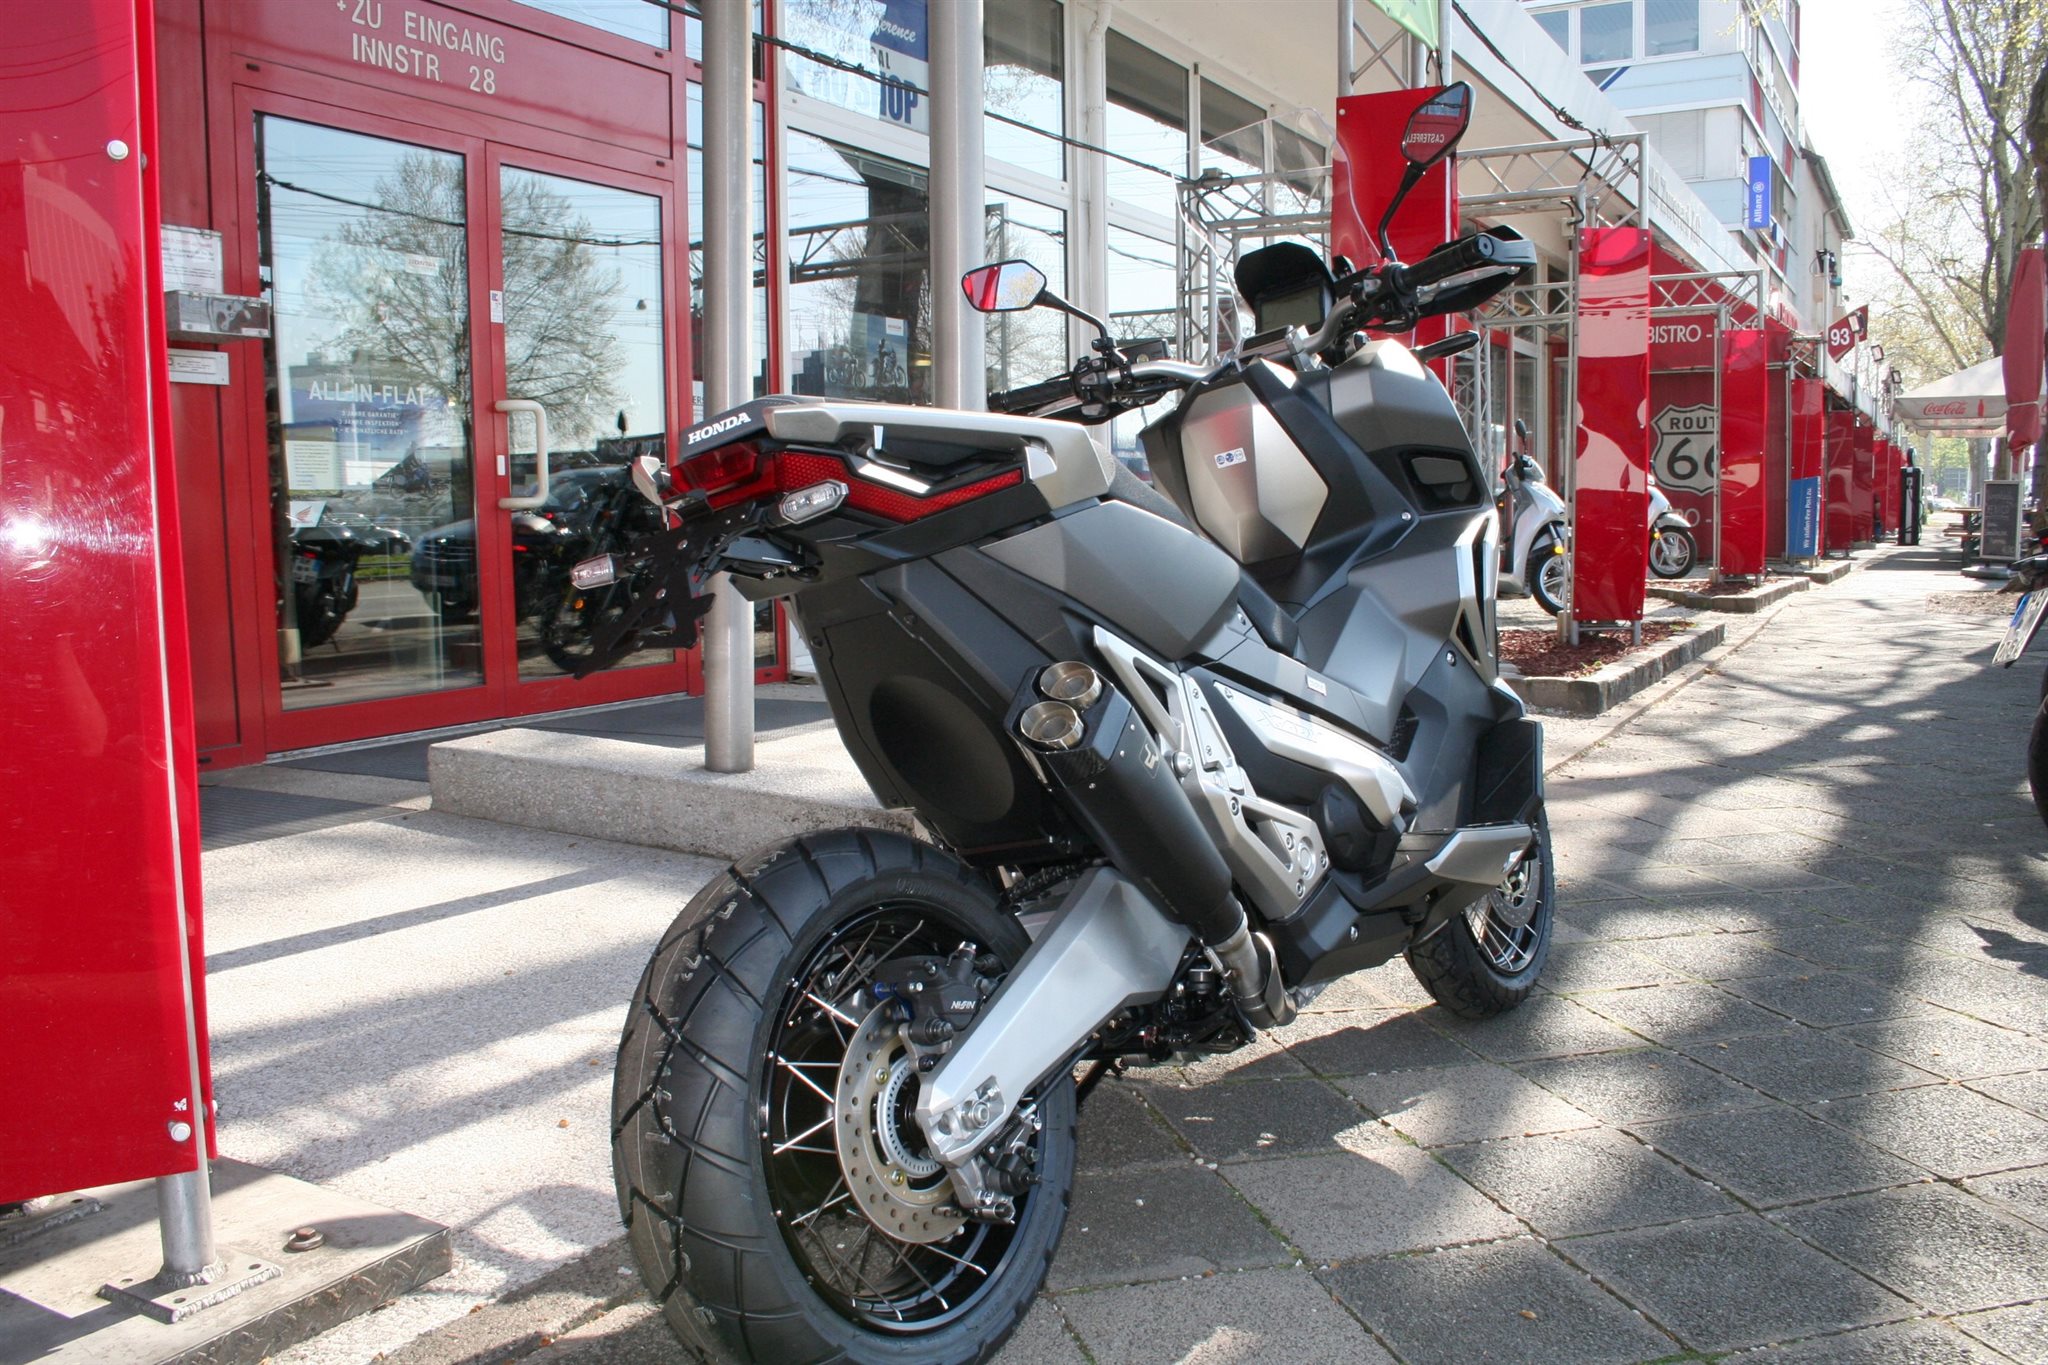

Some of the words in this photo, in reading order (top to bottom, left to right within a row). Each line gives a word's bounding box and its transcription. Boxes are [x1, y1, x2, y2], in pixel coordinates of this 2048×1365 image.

[352, 0, 381, 29] ZU
[405, 10, 505, 64] EINGANG
[352, 33, 443, 83] INNSTR.
[469, 65, 496, 95] 28
[1753, 194, 1763, 223] Allianz
[1648, 324, 1702, 344] BISTRO
[1830, 327, 1850, 346] 93
[309, 381, 425, 406] ALL-IN-FLAT
[688, 412, 752, 445] HONDA
[1670, 416, 1715, 430] ROUT
